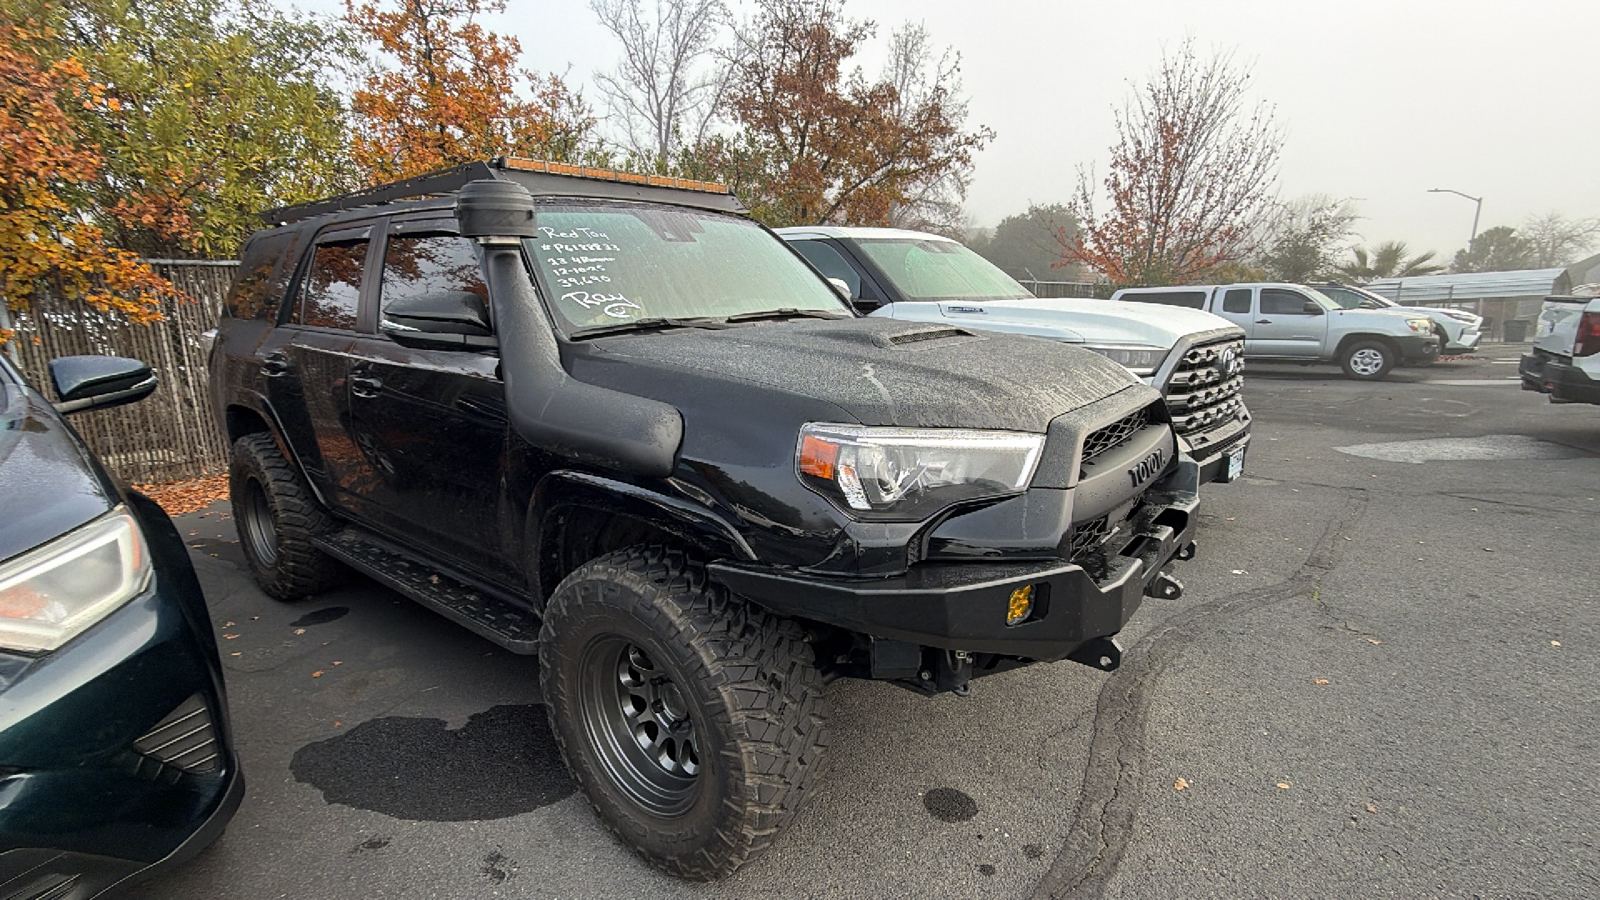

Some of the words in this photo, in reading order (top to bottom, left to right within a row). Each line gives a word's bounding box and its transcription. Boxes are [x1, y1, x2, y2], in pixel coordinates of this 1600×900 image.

[538, 226, 579, 239] Red
[576, 227, 610, 241] Toy
[561, 291, 641, 318] Ray
